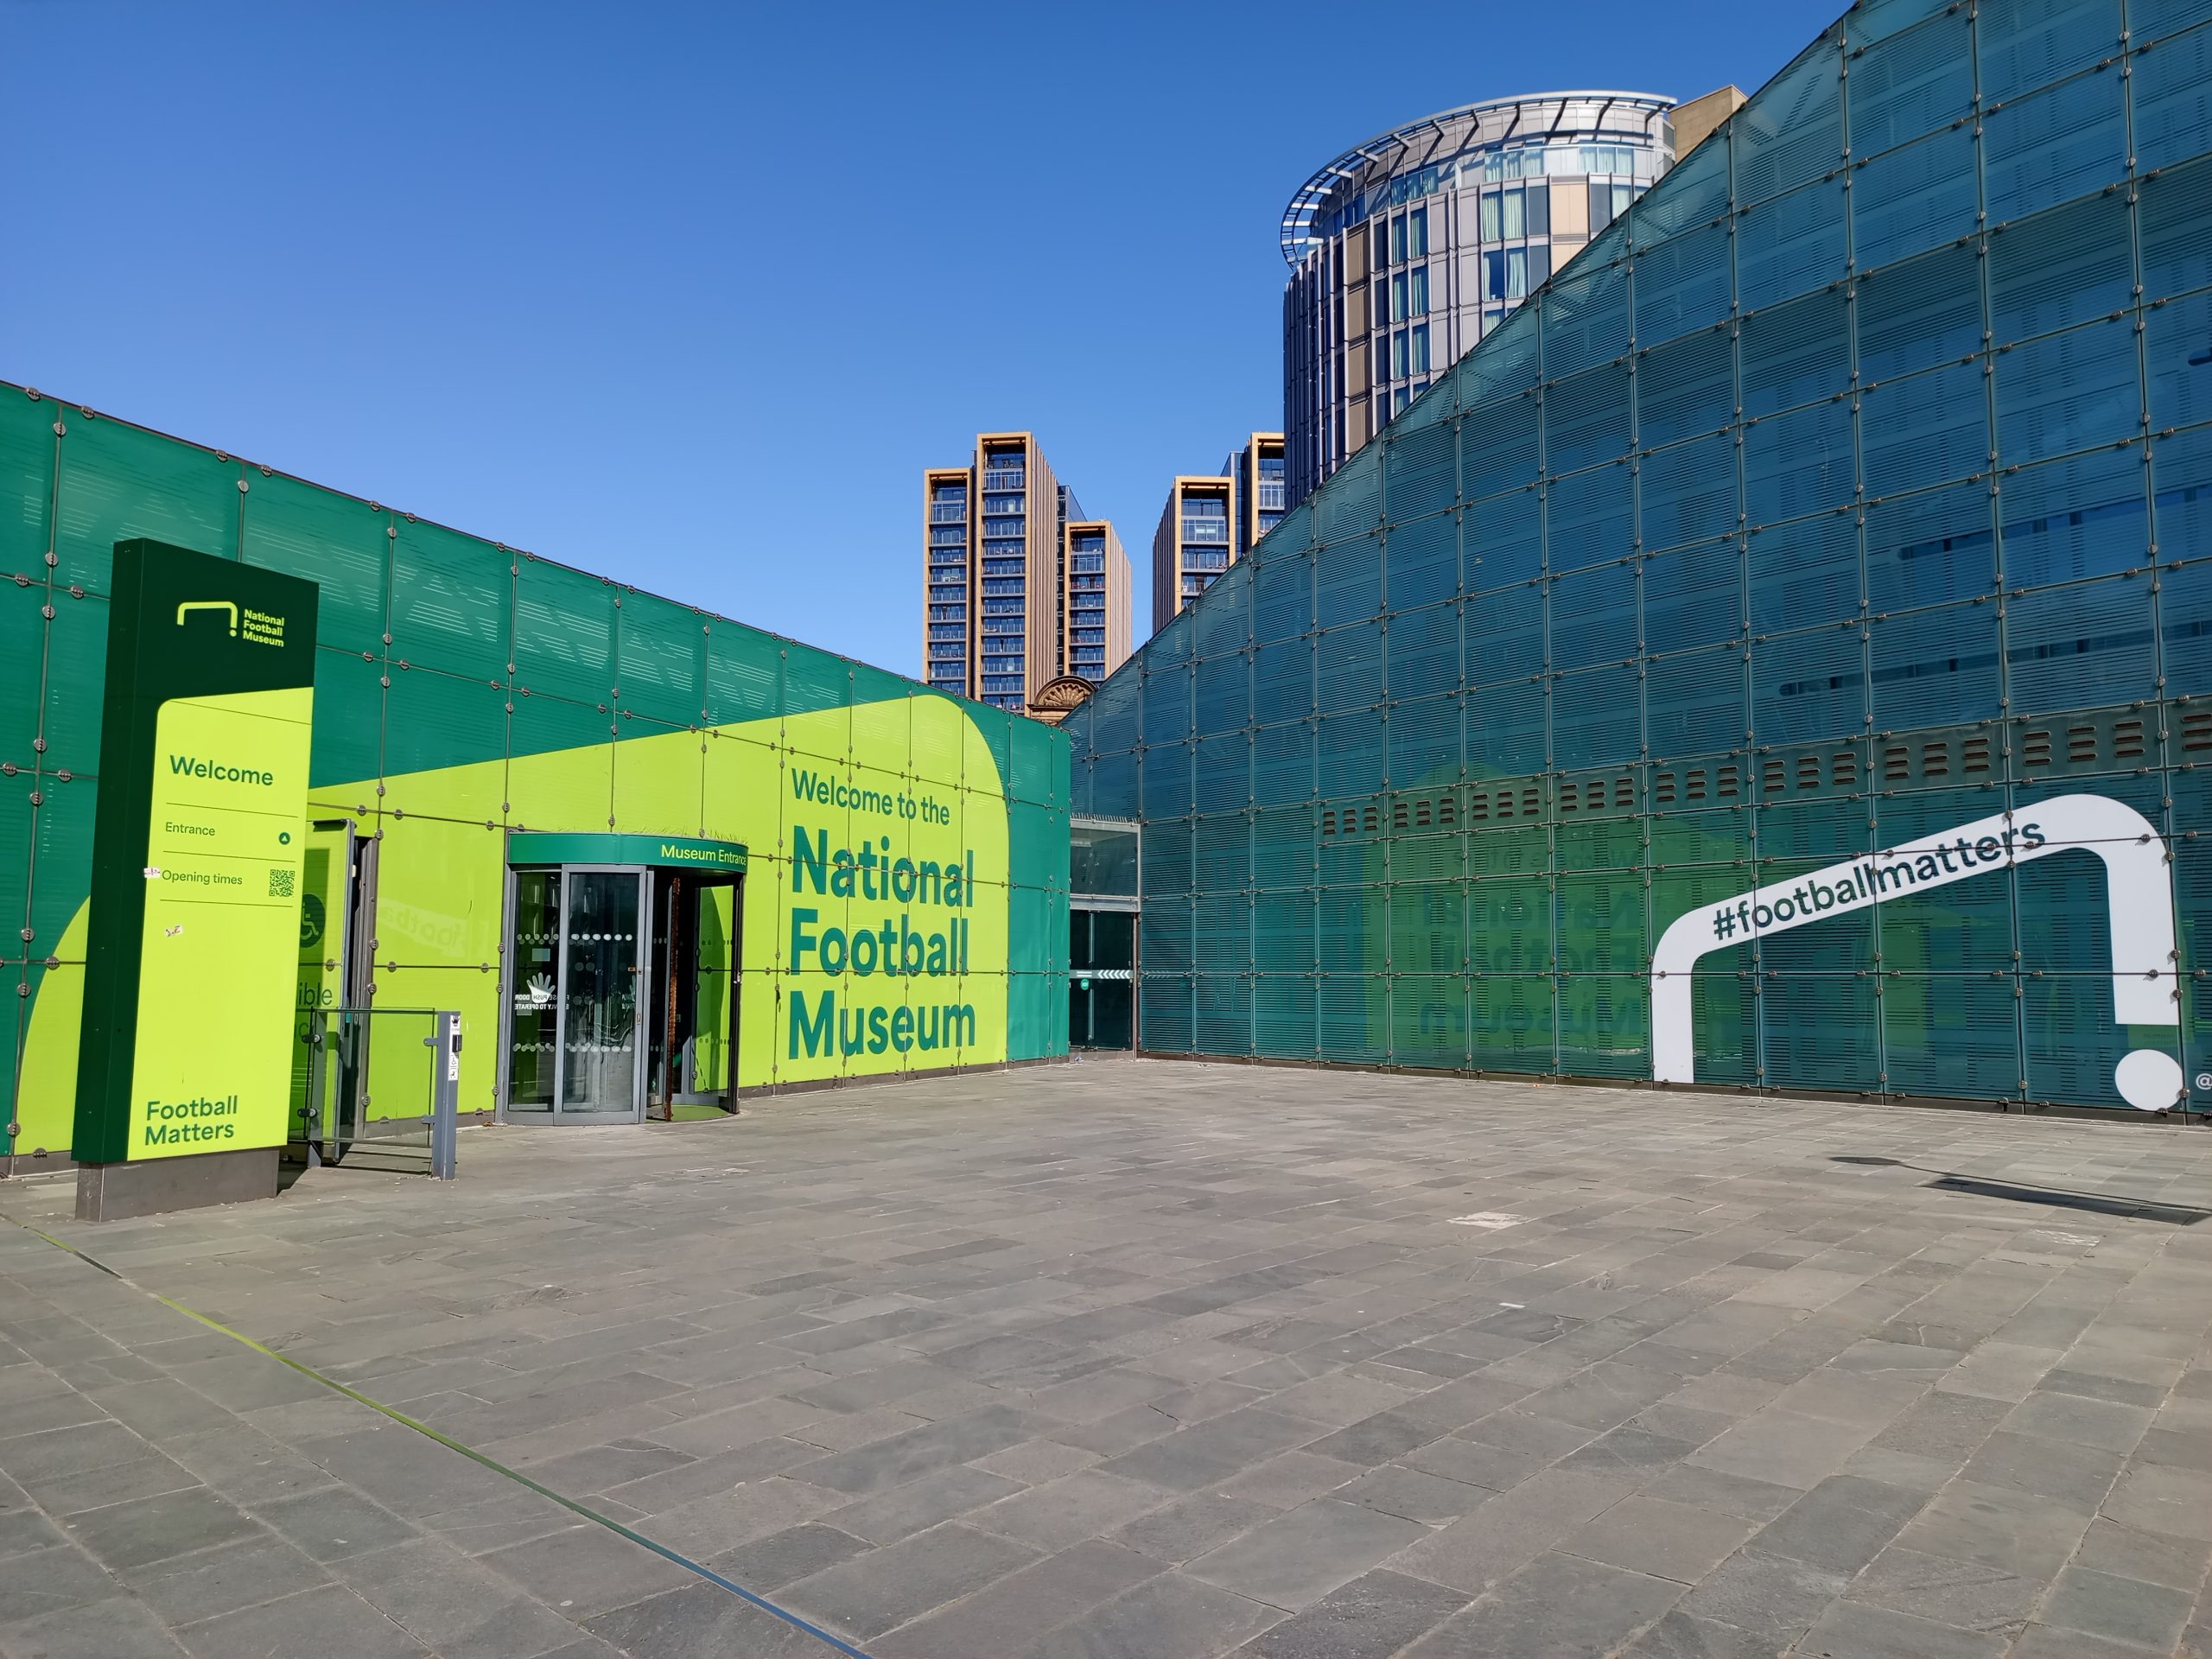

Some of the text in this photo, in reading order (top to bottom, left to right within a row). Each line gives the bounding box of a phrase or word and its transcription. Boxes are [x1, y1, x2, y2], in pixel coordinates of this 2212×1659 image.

[243, 619, 283, 637] Football
[244, 608, 285, 626] National
[243, 629, 284, 647] Museum
[169, 754, 274, 786] Welcome
[791, 767, 950, 826] Welcome to the
[165, 822, 216, 836] Entrance
[661, 844, 747, 866] Museum Entrance
[791, 824, 975, 908] National
[162, 869, 211, 886] Opening
[213, 873, 243, 886] times
[1713, 823, 2046, 942] #footballmatters
[790, 906, 969, 977] Football
[788, 989, 976, 1060] Museum
[146, 1095, 238, 1121] Football
[145, 1123, 235, 1146] Matters
